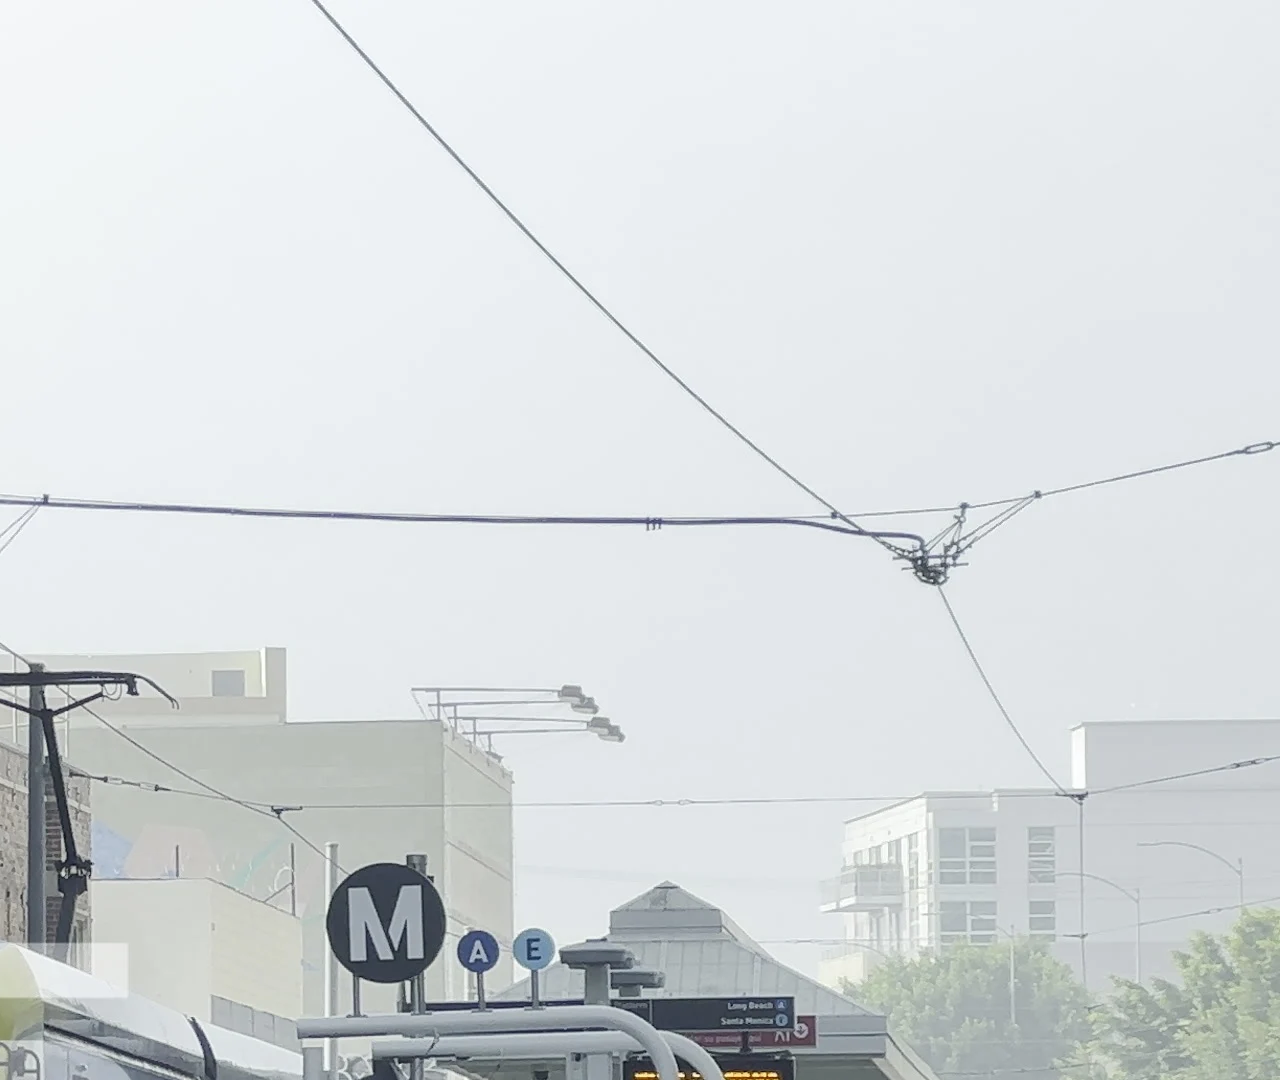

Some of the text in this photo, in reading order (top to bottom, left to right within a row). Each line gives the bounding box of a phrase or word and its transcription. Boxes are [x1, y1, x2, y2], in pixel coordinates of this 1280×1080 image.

[347, 884, 425, 962] M
[469, 940, 489, 963] A
[526, 938, 542, 961] E
